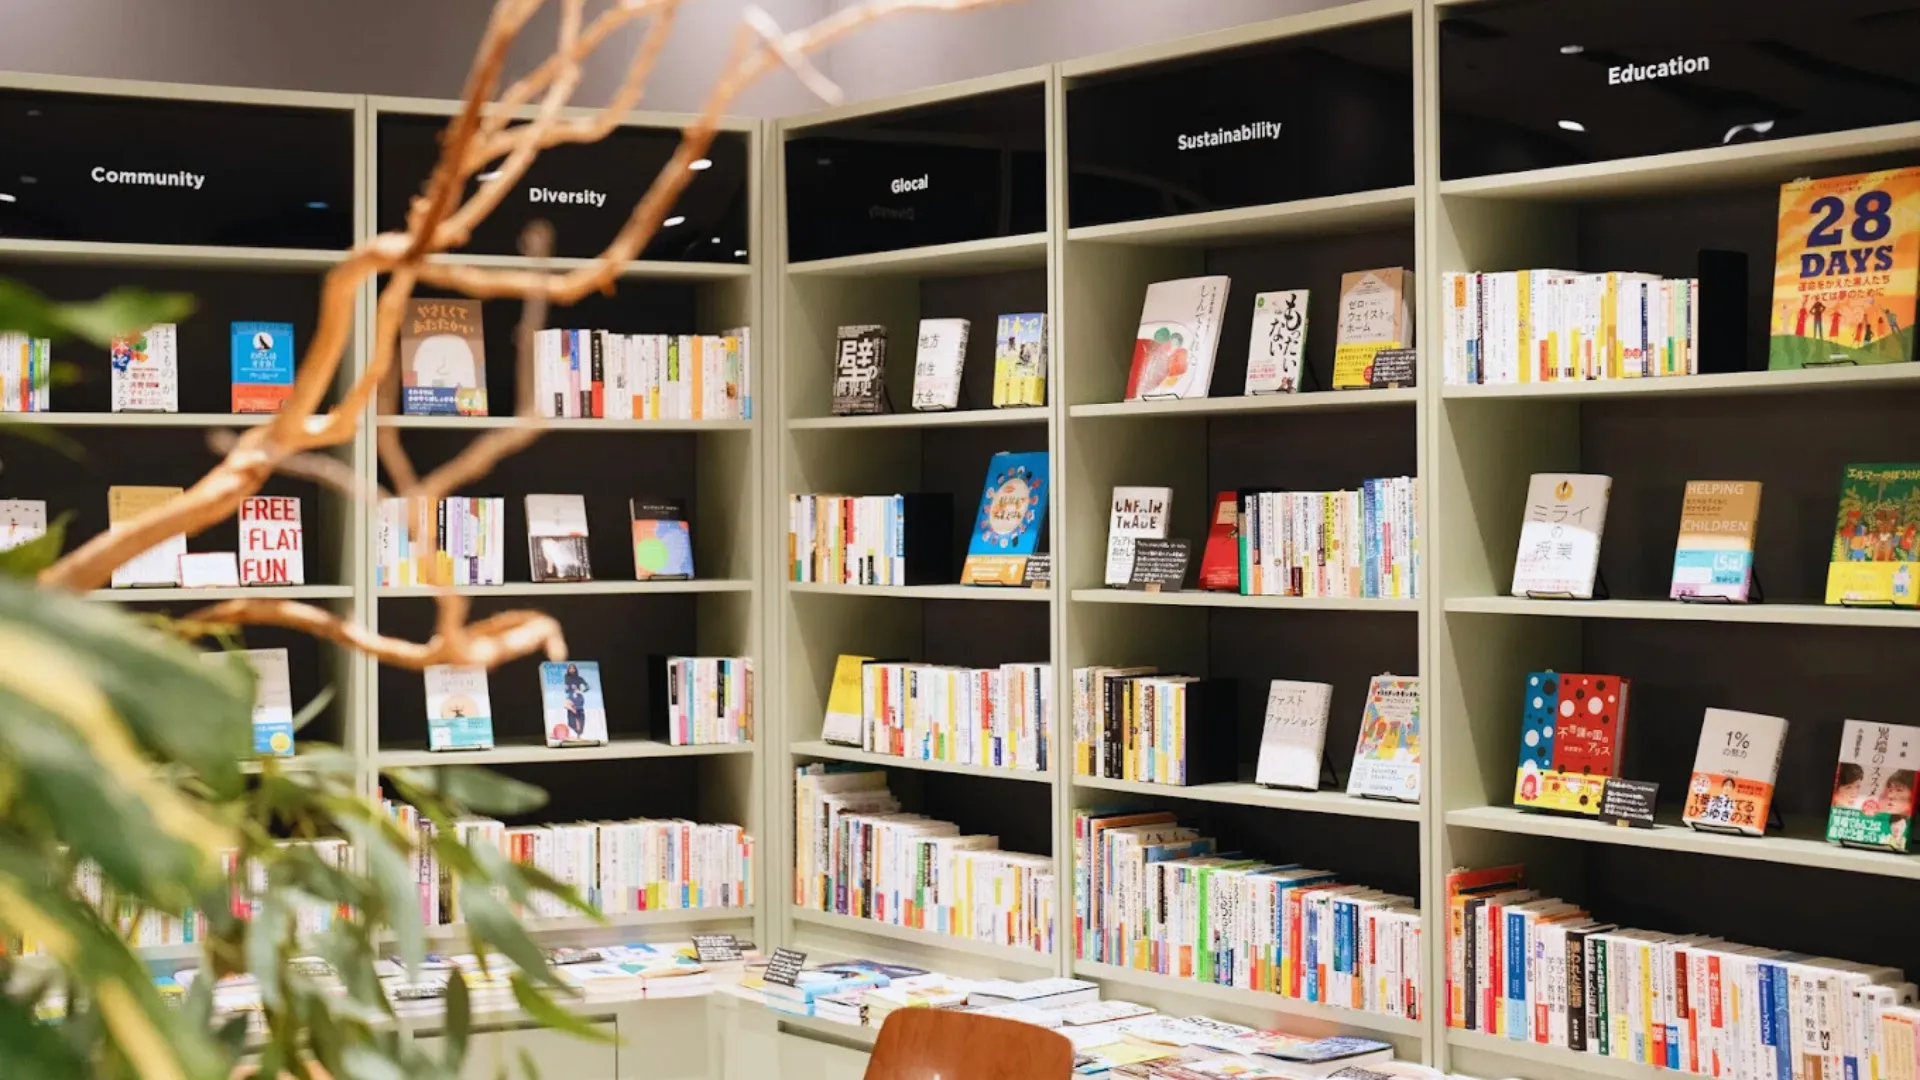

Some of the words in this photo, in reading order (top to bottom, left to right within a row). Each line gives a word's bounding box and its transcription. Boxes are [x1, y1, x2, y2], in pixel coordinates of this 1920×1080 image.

[1608, 55, 1710, 85] Education
[1178, 121, 1282, 150] Sustainability
[91, 166, 205, 190] Community
[891, 173, 928, 194] Glocal
[529, 187, 607, 208] Diversity
[1807, 190, 1892, 247] 28
[1800, 246, 1893, 278] DAYS
[1686, 484, 1745, 495] HELPING
[242, 498, 297, 521] FREE
[1532, 504, 1590, 524] ミライ
[1681, 520, 1749, 532] CHILDREN
[250, 528, 303, 551] FLAT
[243, 558, 288, 582] FUN
[1726, 731, 1750, 749] 1%
